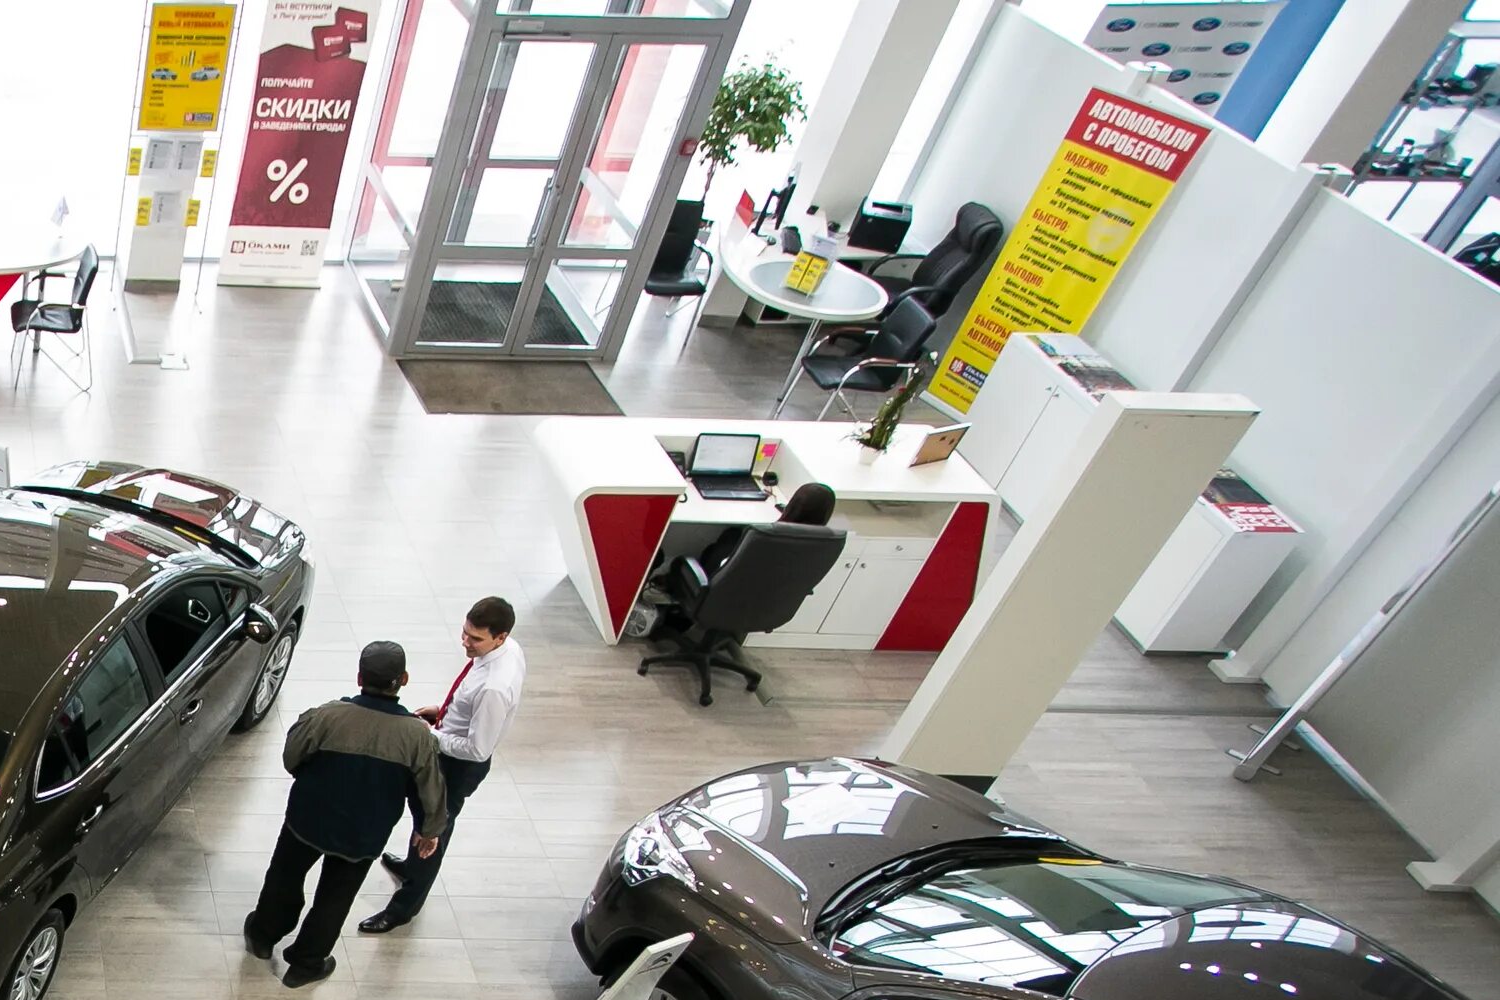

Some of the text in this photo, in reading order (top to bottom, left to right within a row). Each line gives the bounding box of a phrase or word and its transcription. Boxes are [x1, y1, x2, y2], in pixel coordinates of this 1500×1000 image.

[260, 77, 315, 89] ПОЛУЧАЙТЕ
[256, 97, 352, 122] СКИДКИ
[260, 121, 311, 131] ЗАВЕДЕНИЯХ
[1088, 98, 1198, 152] АВТОМОБИЛИ
[1083, 122, 1178, 172] С ПРОБЕГОМ
[1064, 150, 1110, 177] НАДЕЖНО:
[1032, 208, 1070, 232] БЫСТРО:
[1003, 260, 1045, 289] ВЫГОДНО:
[974, 314, 1011, 340] БЫСТРЫ
